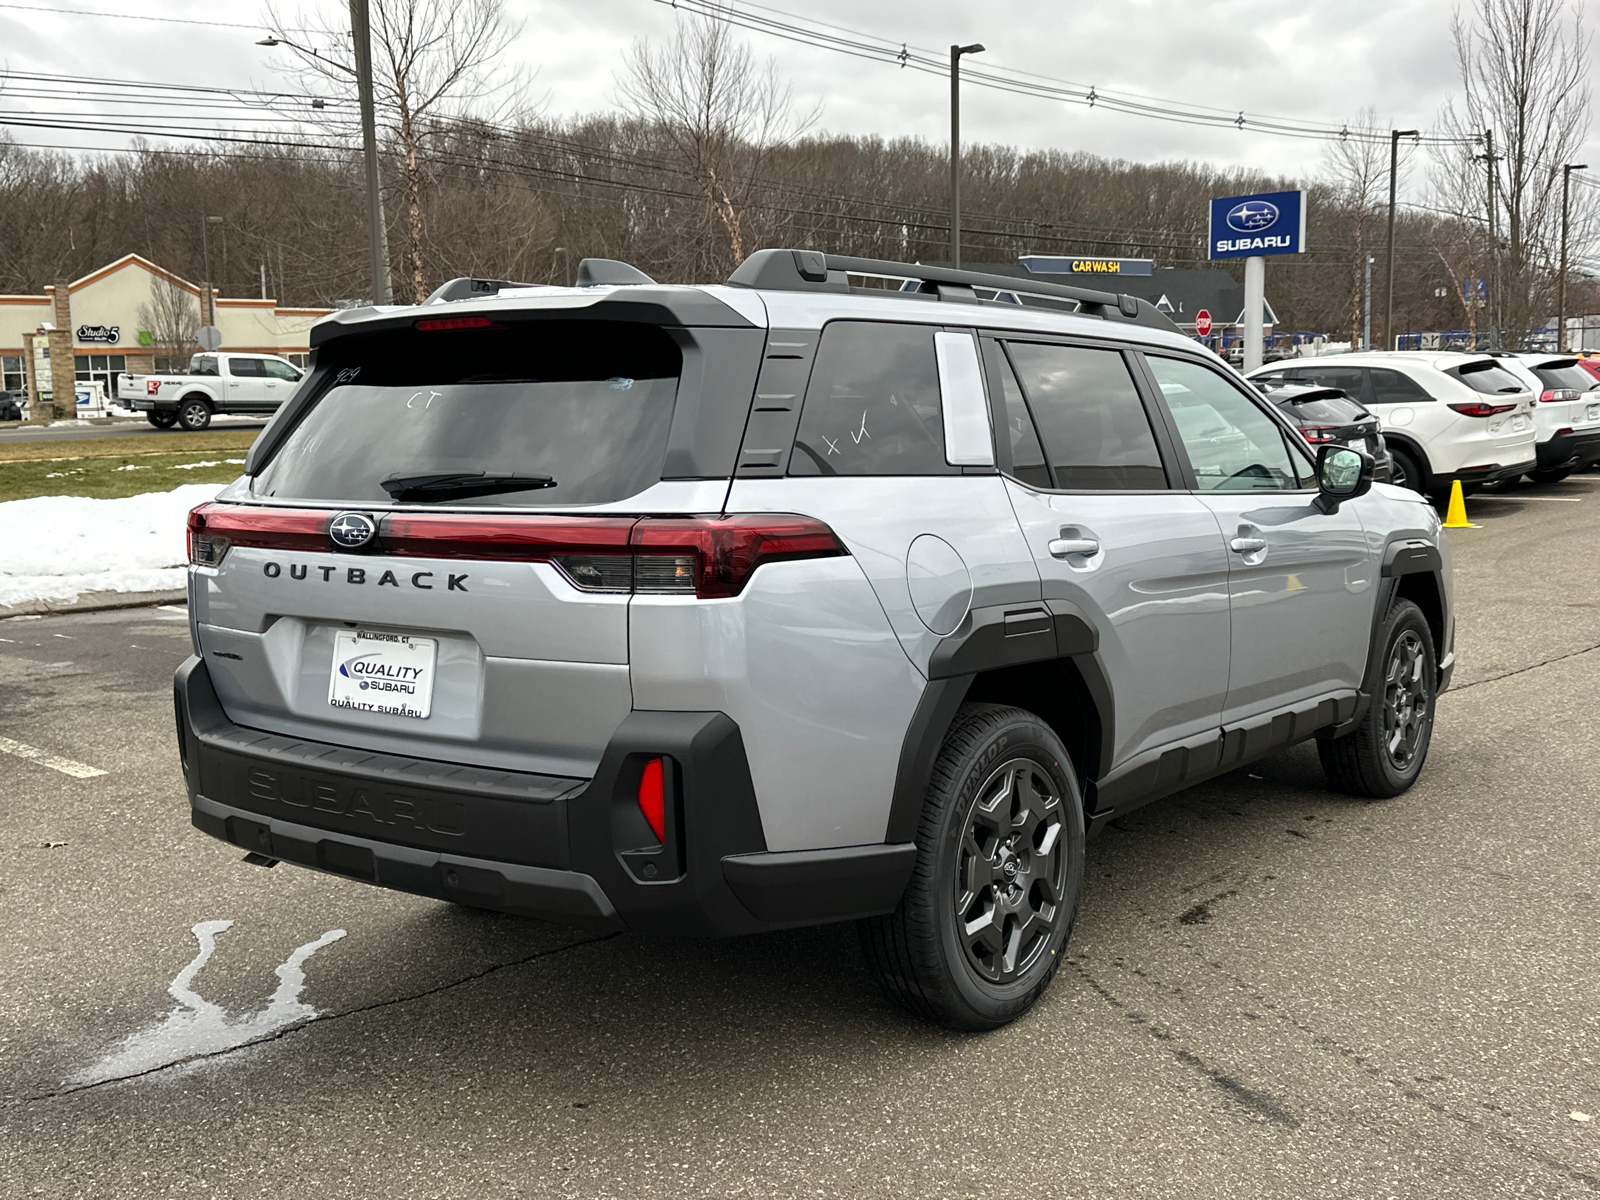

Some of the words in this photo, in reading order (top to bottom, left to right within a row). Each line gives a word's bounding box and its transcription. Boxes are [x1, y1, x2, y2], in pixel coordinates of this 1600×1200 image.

[1216, 235, 1290, 252] SUBARU
[1072, 260, 1120, 273] CARWASH
[1197, 317, 1211, 328] STOP
[78, 325, 110, 337] Studio
[108, 327, 119, 343] 5
[263, 561, 469, 592] OUTBACK
[401, 636, 410, 644] CT
[353, 661, 424, 680] QUALITY
[370, 681, 415, 695] SUBARU
[330, 698, 374, 711] QUALITY
[377, 705, 422, 718] SUBARU
[956, 735, 1008, 813] DUNLOP
[247, 766, 468, 837] SUBARU
